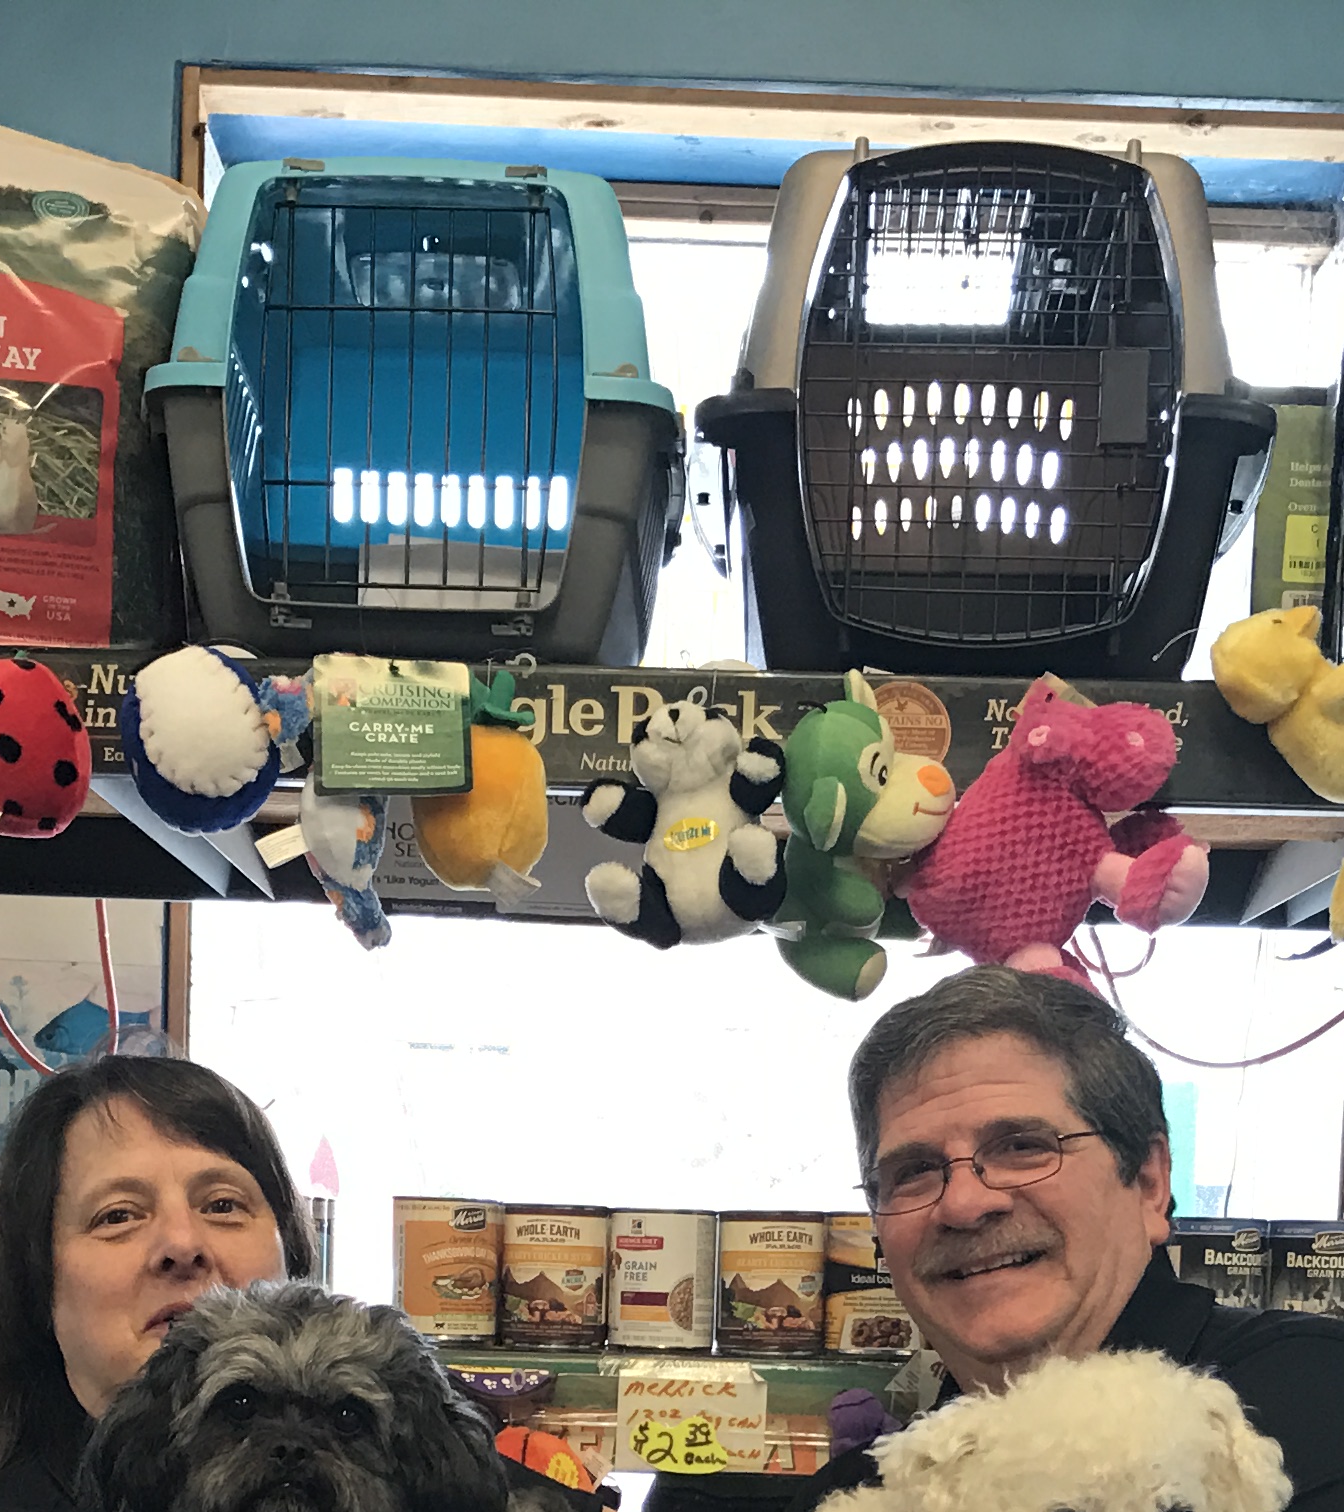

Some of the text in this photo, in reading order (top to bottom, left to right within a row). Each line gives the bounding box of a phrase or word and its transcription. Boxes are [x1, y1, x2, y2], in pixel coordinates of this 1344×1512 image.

[359, 682, 451, 699] CRUISING
[360, 696, 450, 709] COMPANION
[349, 722, 434, 735] CARRY-ME
[364, 732, 419, 744] CRATE
[516, 1225, 581, 1240] WHOLE EARTH
